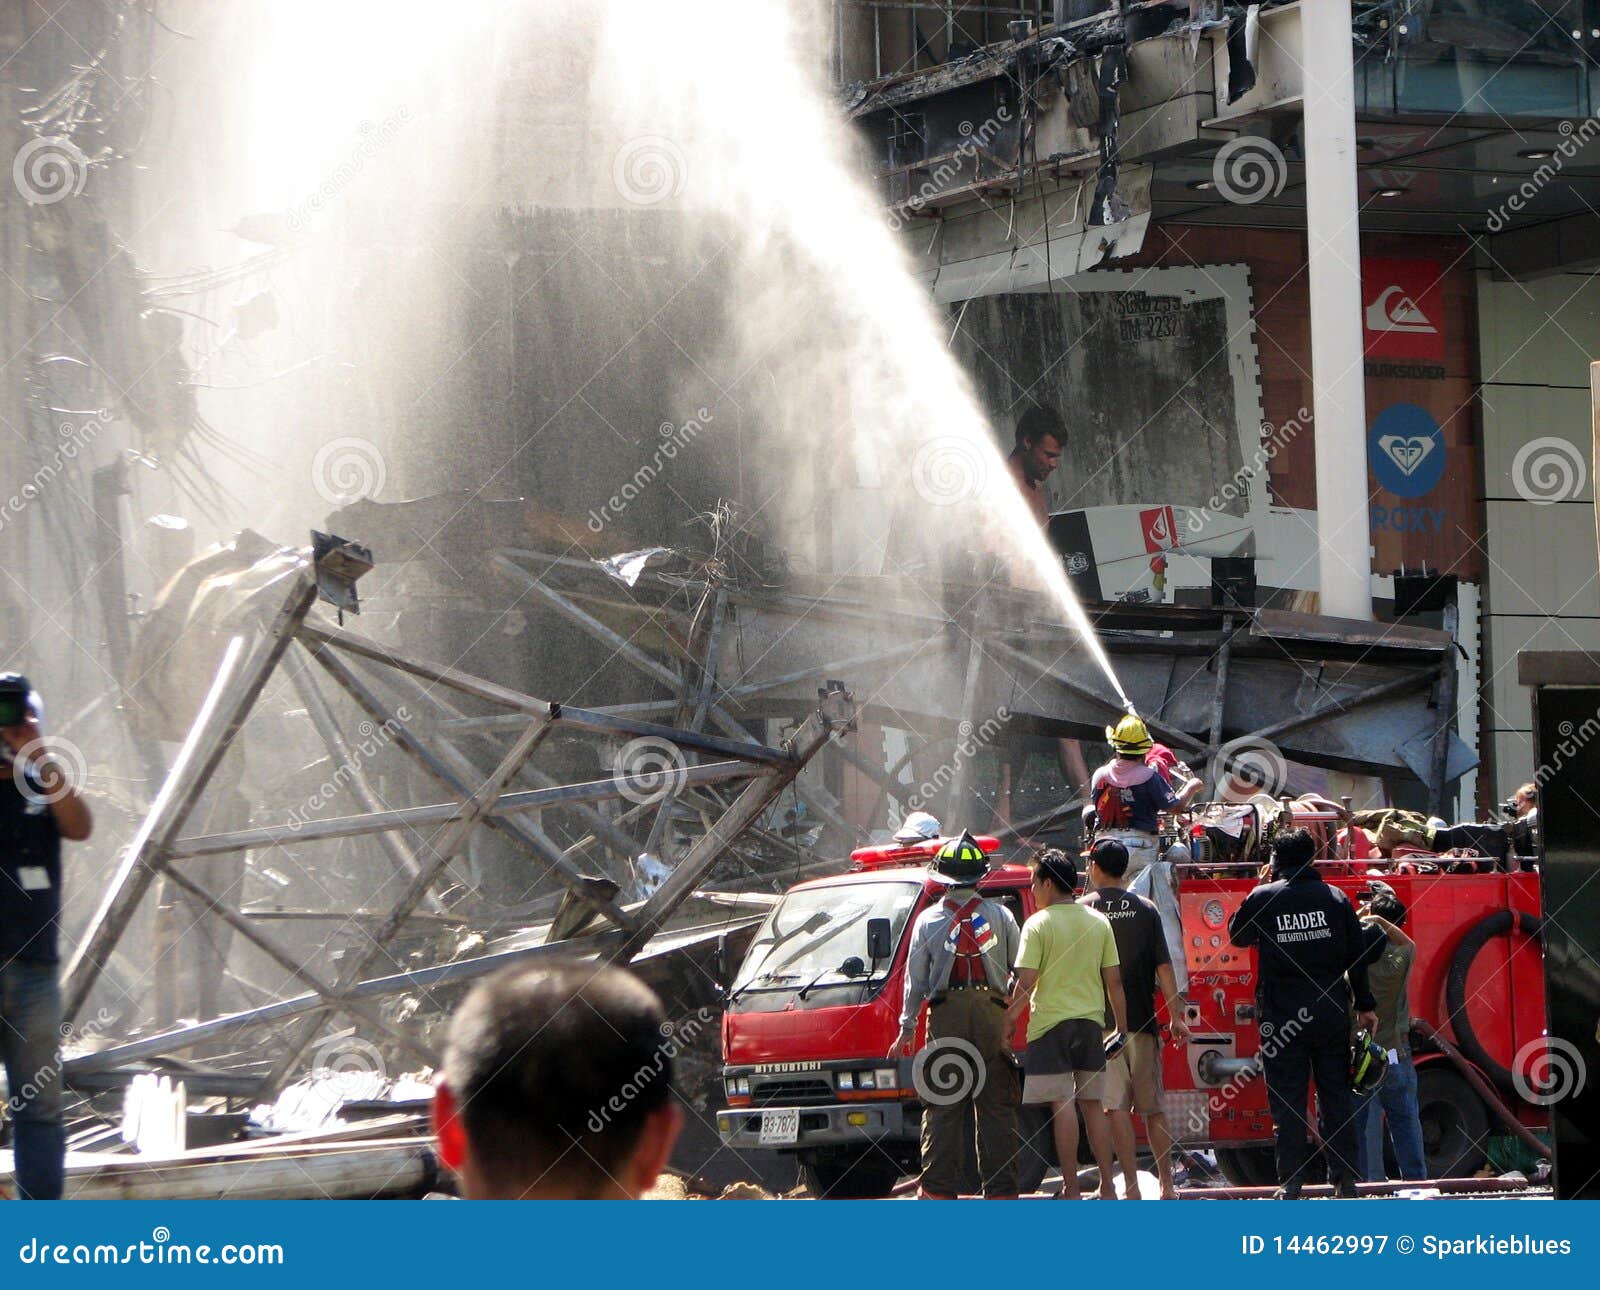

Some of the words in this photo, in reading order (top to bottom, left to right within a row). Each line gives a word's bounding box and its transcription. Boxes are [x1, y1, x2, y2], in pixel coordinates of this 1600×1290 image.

[1371, 505, 1447, 532] ROXY
[1276, 910, 1328, 931] LEADER
[1287, 931, 1304, 942] SAFETY
[755, 1061, 821, 1074] MITSUBISHI
